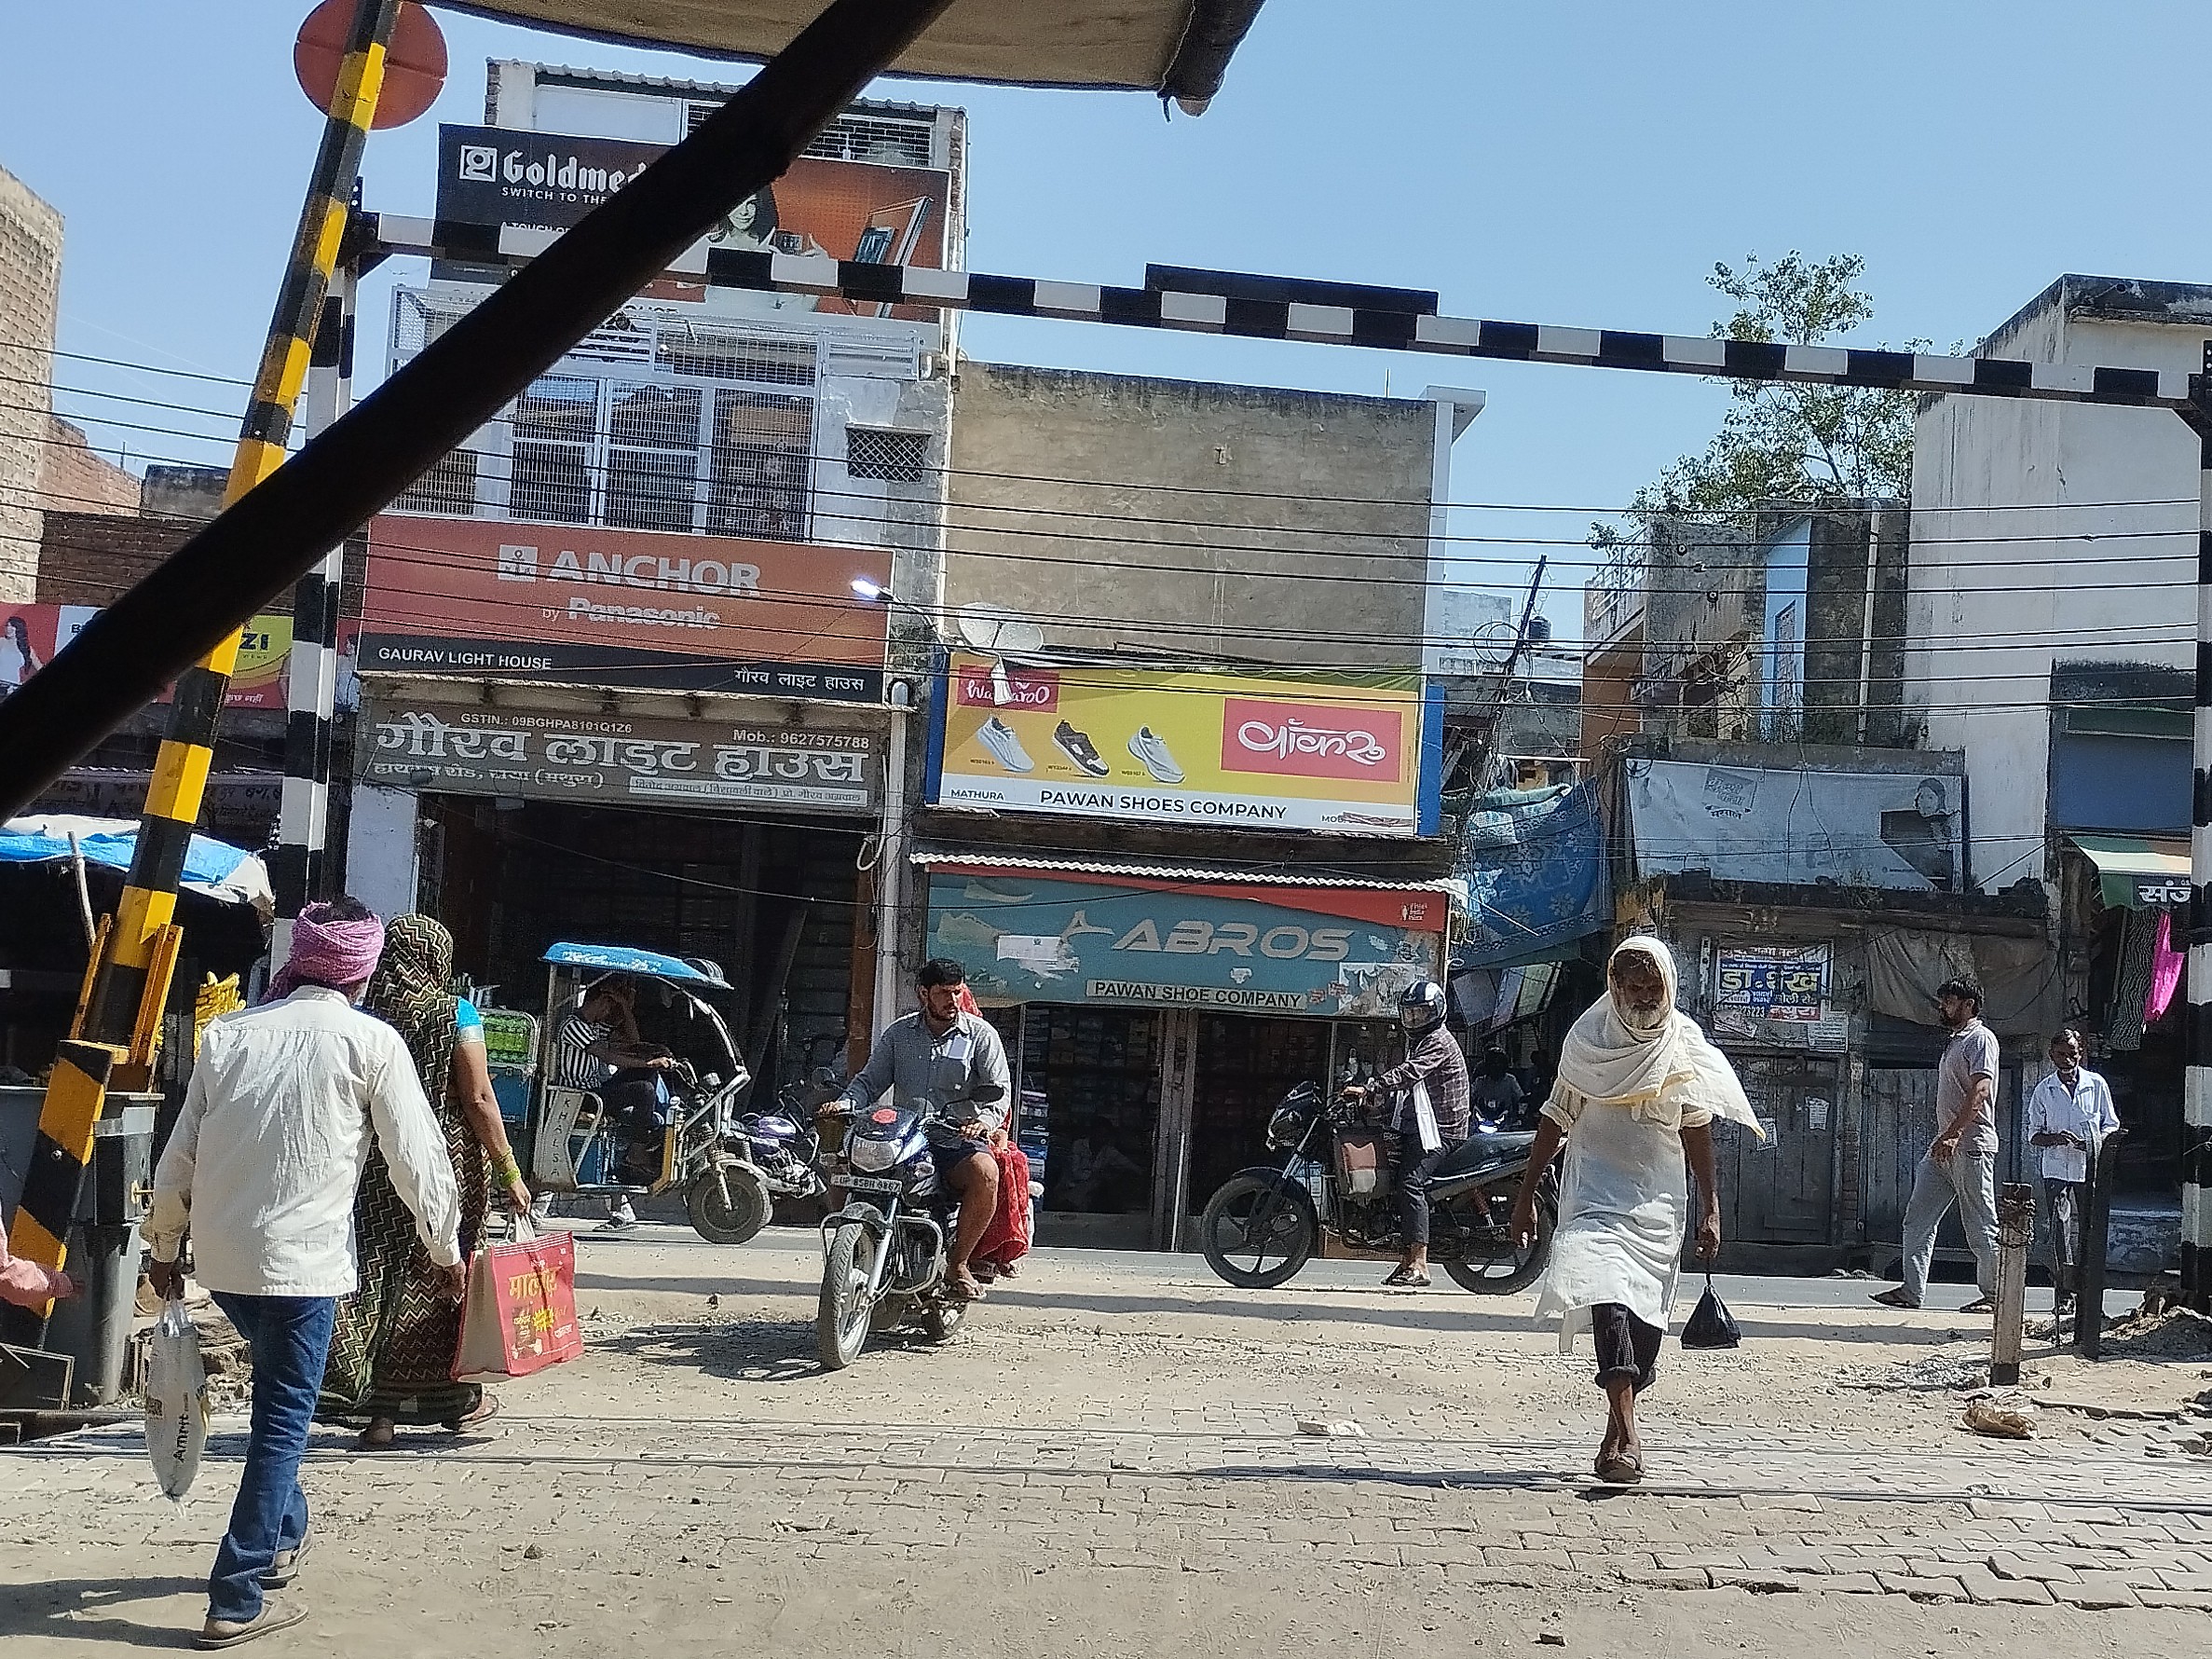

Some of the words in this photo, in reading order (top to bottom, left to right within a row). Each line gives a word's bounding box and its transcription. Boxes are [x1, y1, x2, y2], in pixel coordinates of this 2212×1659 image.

[501, 186, 553, 200] SWITCH
[559, 191, 577, 202] TO
[546, 550, 760, 597] ANCHOR
[542, 606, 559, 622] by
[568, 596, 720, 629] Panasonic
[378, 647, 444, 663] GAURAV
[448, 651, 495, 665] LIGHT
[498, 654, 553, 670] HOUSE
[734, 665, 771, 685] गौरव
[777, 672, 816, 689] लाइट
[825, 675, 865, 692] हाउस
[375, 711, 531, 761] गौरव
[543, 733, 701, 776] लाइट
[713, 743, 870, 783] हाउस
[732, 729, 775, 744] Mob.:
[780, 732, 870, 749] 9627575788
[950, 788, 1004, 802] MATHURA
[1040, 789, 1113, 809] PAWAN
[1119, 795, 1184, 814] SHOES
[1190, 800, 1288, 820] COMPANY
[1112, 917, 1355, 962] ABROS
[1095, 981, 1157, 1000] PAWAN
[1162, 985, 1209, 1002] SHOE
[1215, 988, 1301, 1008] COMPANY
[550, 1097, 572, 1180] KHALSA
